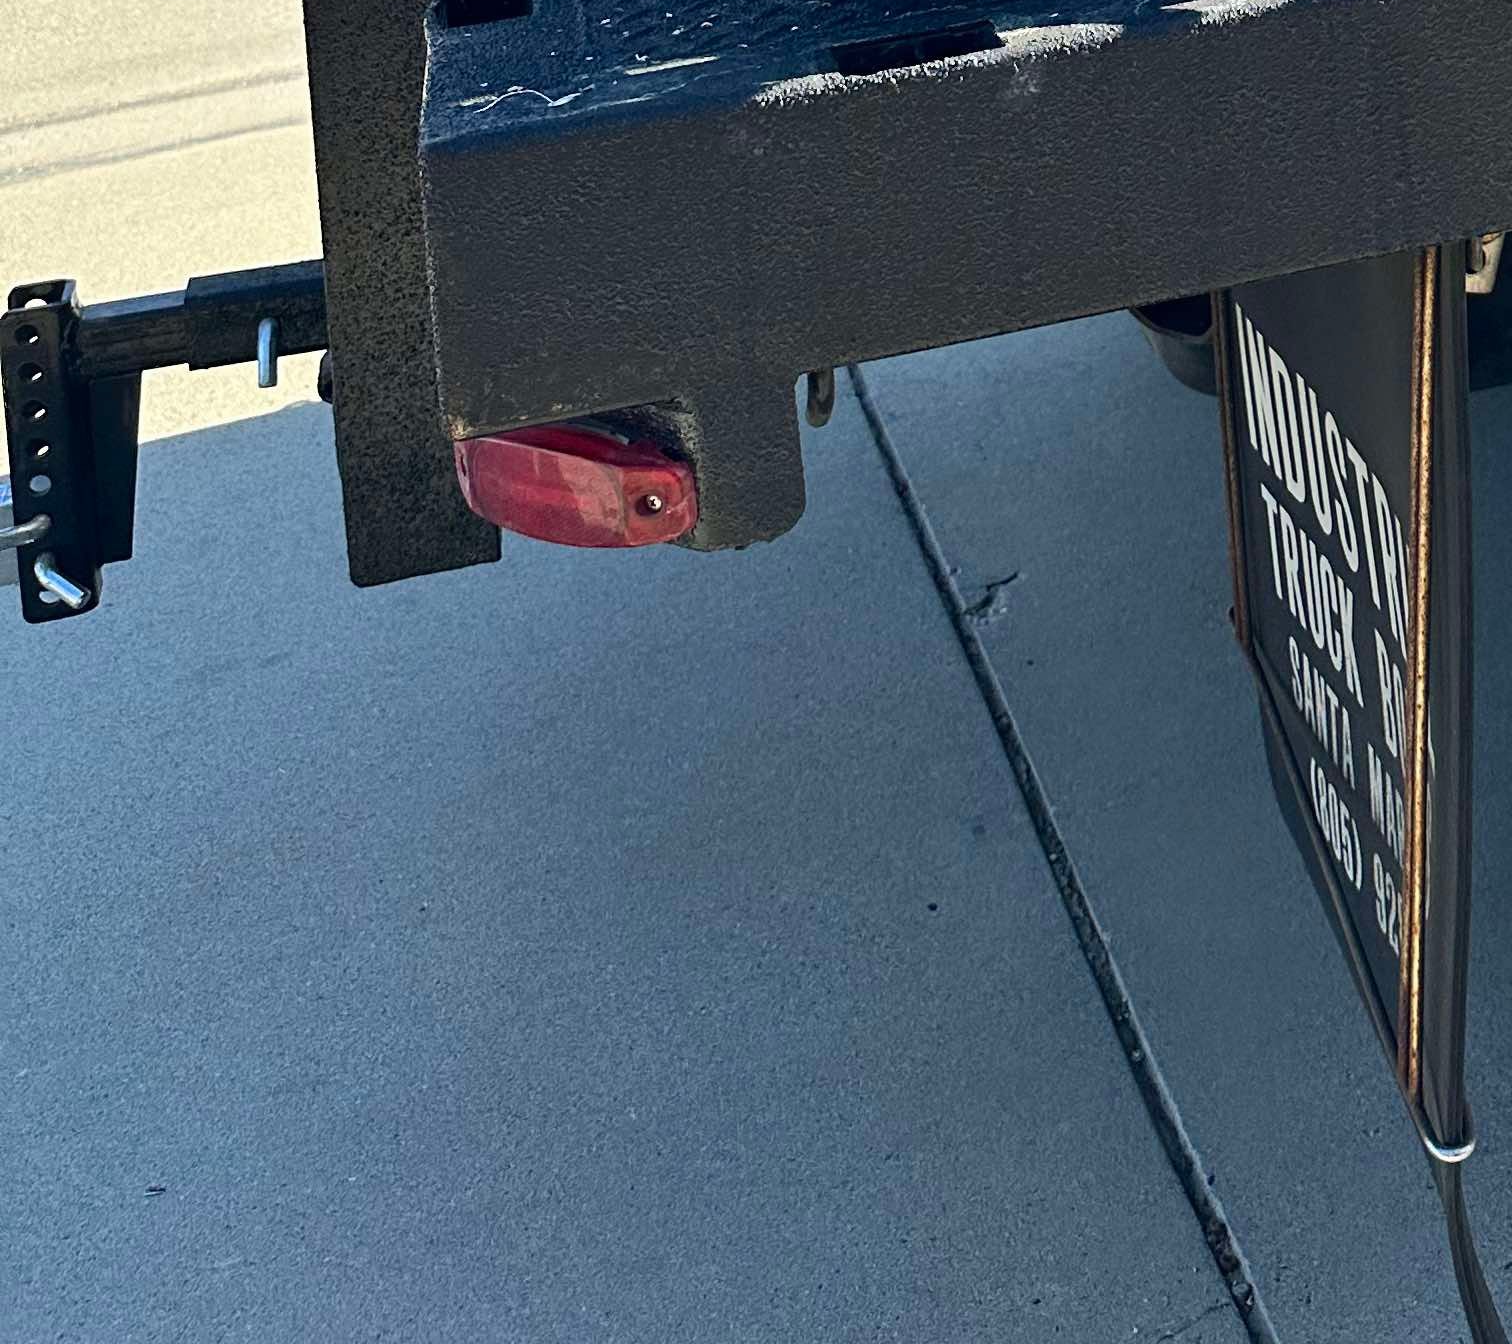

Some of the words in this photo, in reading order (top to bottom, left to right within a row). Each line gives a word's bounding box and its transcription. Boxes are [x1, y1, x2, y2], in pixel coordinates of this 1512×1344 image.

[1235, 302, 1409, 662] INDUSTRI
[1261, 483, 1363, 708] TRUCK
[1374, 628, 1407, 778] BO
[1289, 635, 1355, 790] SANTA
[1310, 757, 1362, 891] (805)
[1374, 853, 1402, 958] 92
